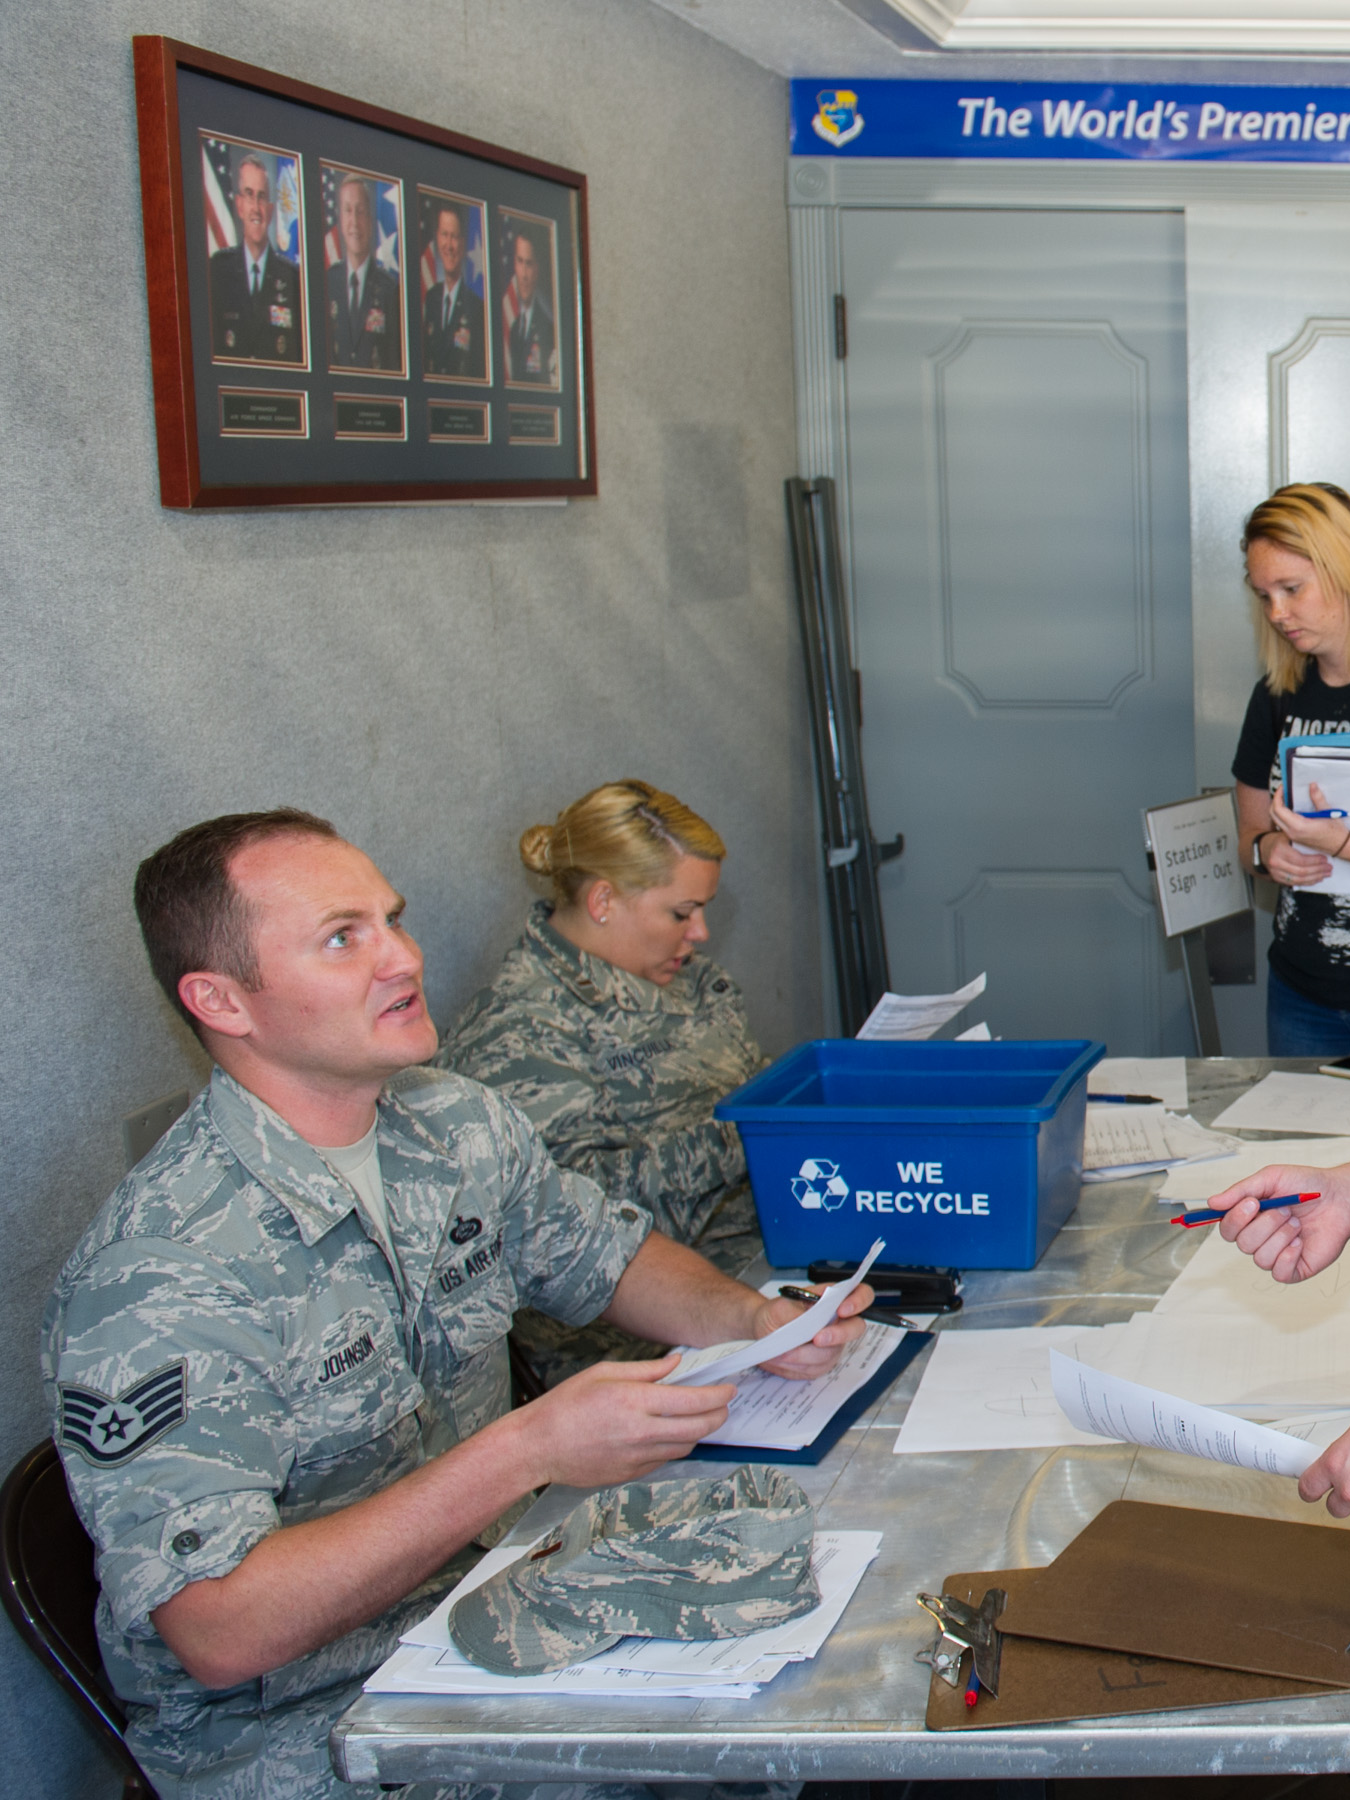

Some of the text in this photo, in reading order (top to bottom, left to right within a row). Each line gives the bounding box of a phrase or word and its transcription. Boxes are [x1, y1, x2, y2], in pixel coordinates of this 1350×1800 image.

[958, 97, 1032, 138] The
[1043, 99, 1189, 141] World's
[1165, 834, 1228, 867] Station #7
[1169, 873, 1196, 894] Sign
[1213, 861, 1233, 879] Out
[897, 1161, 944, 1184] WE
[855, 1190, 990, 1216] RECYCLE
[465, 1250, 492, 1278] AIR
[318, 1331, 376, 1383] JOHNSON
